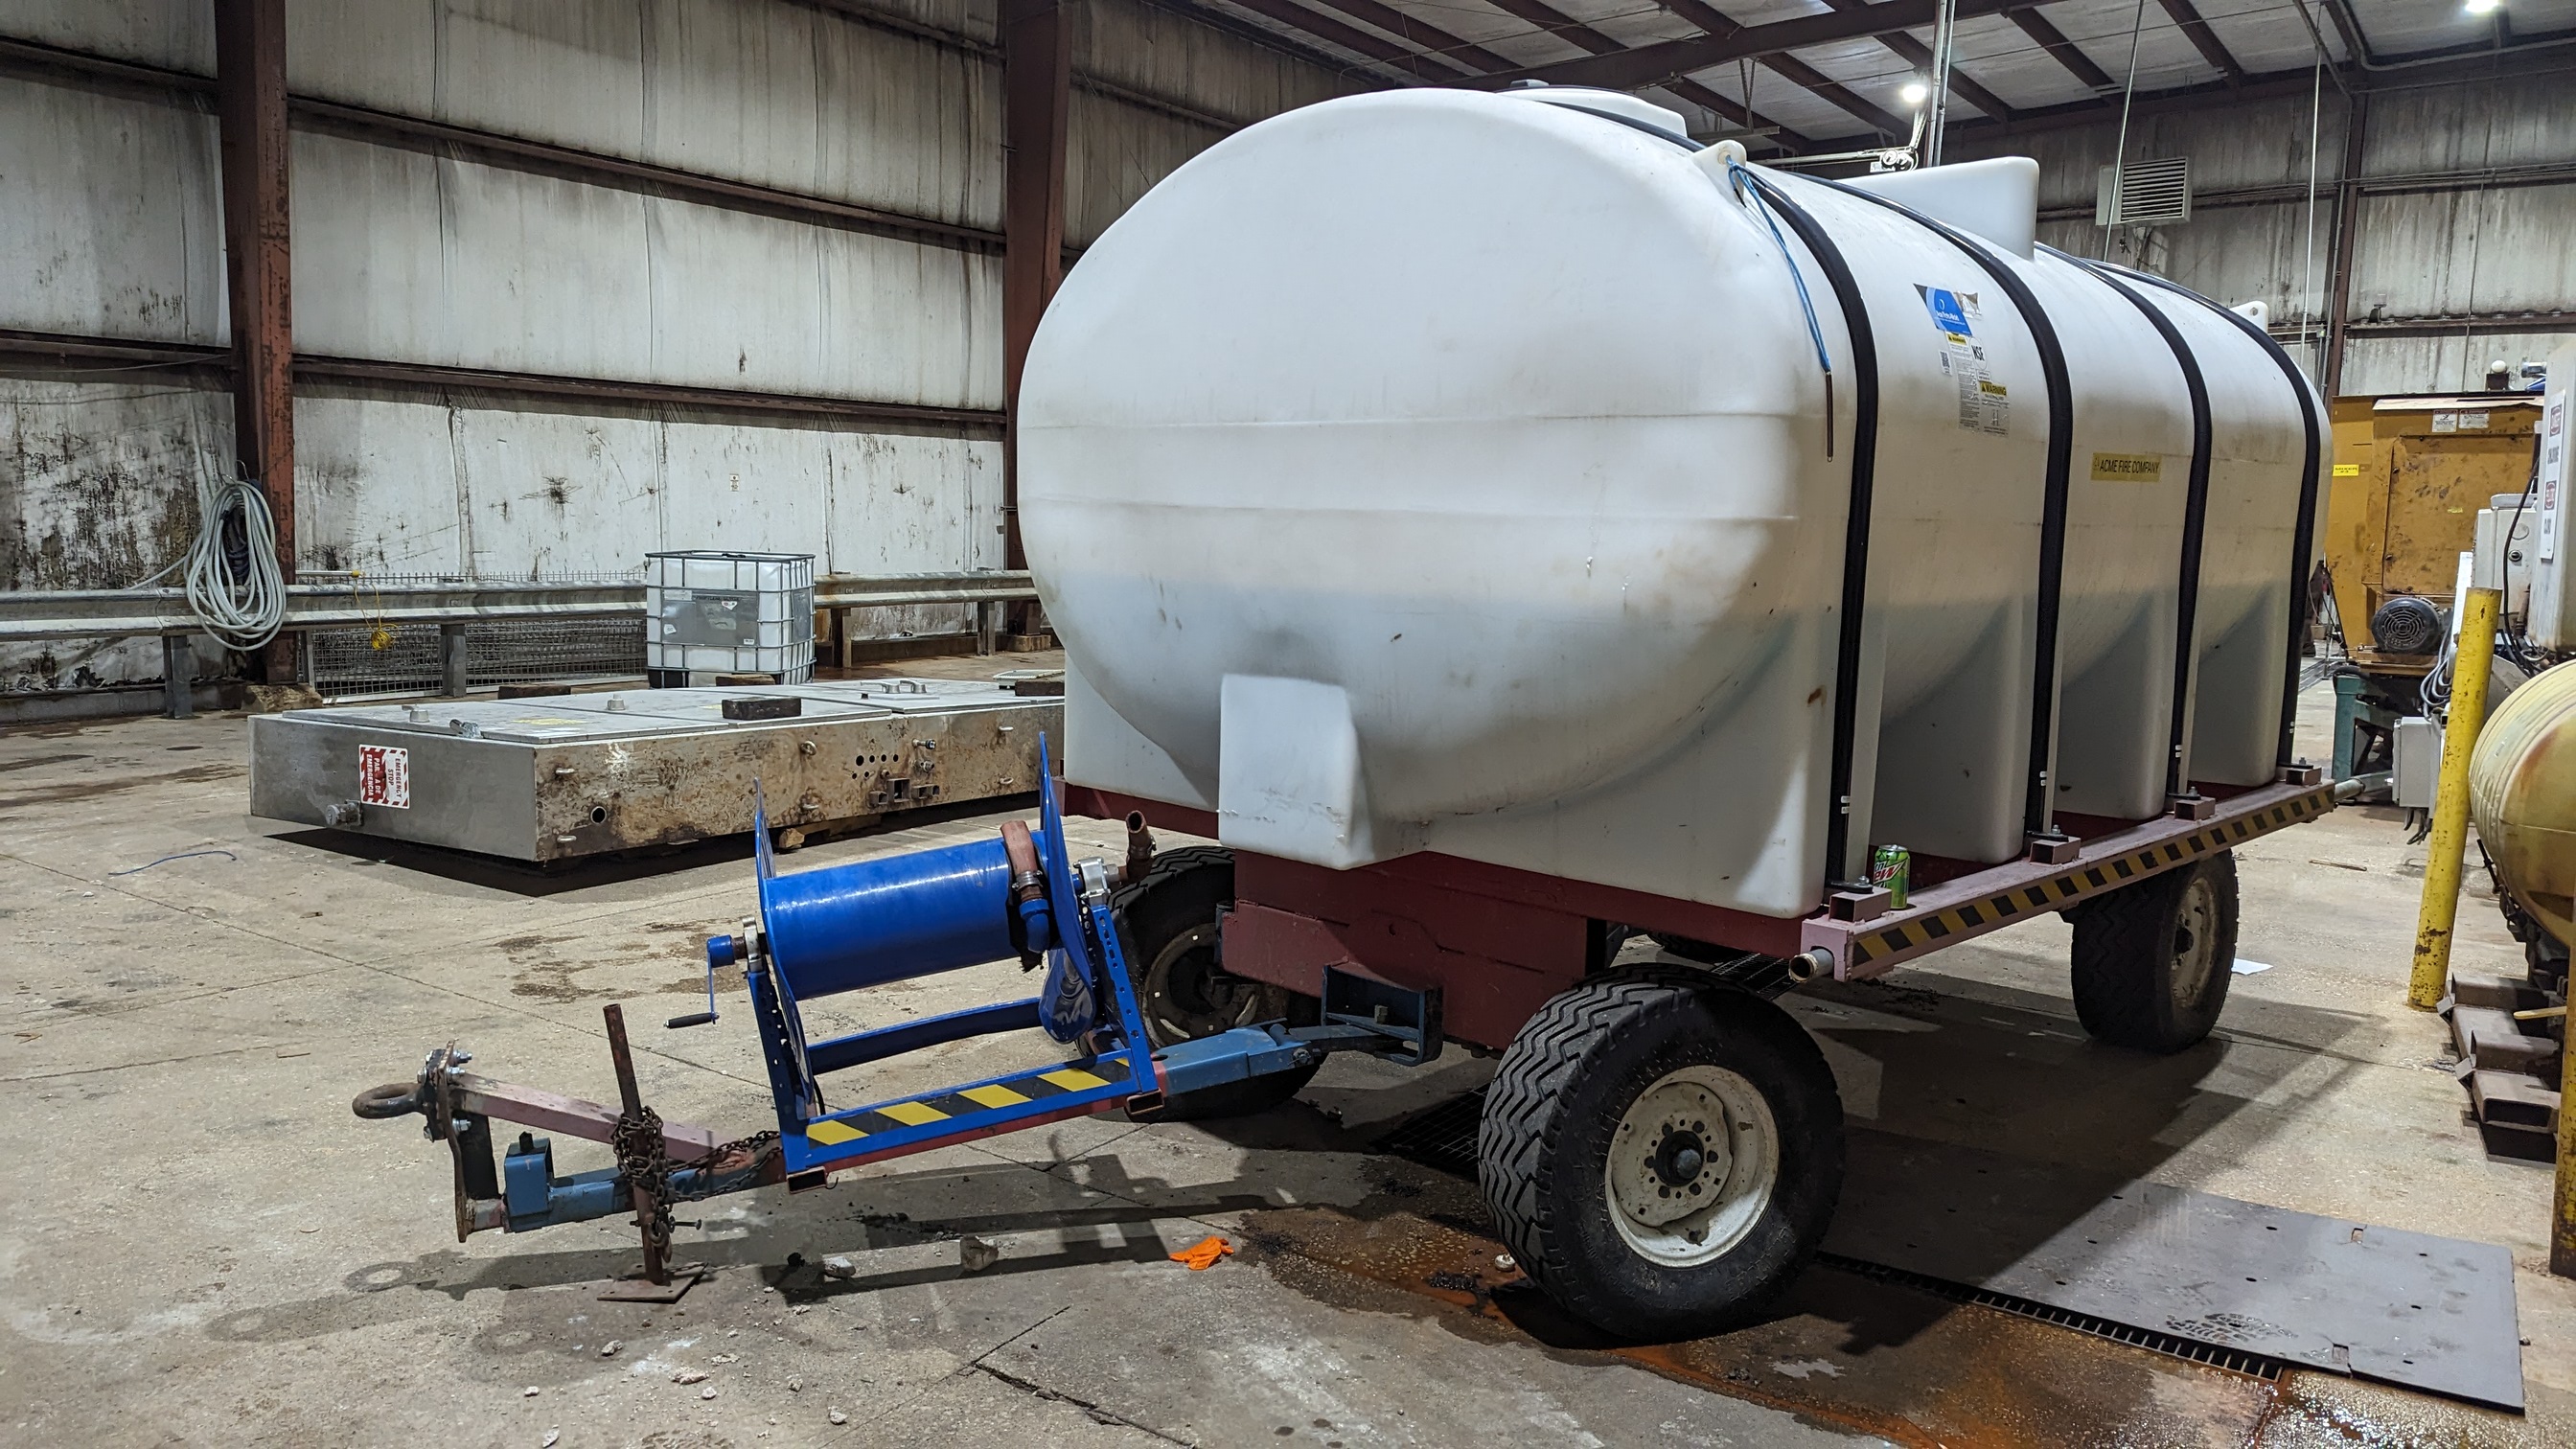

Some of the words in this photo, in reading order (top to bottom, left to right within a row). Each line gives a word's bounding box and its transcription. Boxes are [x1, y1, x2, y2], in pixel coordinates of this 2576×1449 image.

[1971, 345, 1985, 361] NSF
[2100, 459, 2118, 472] ACME
[2118, 460, 2132, 473] FIRE
[2132, 460, 2160, 474] COMPANY
[375, 786, 381, 794] DE
